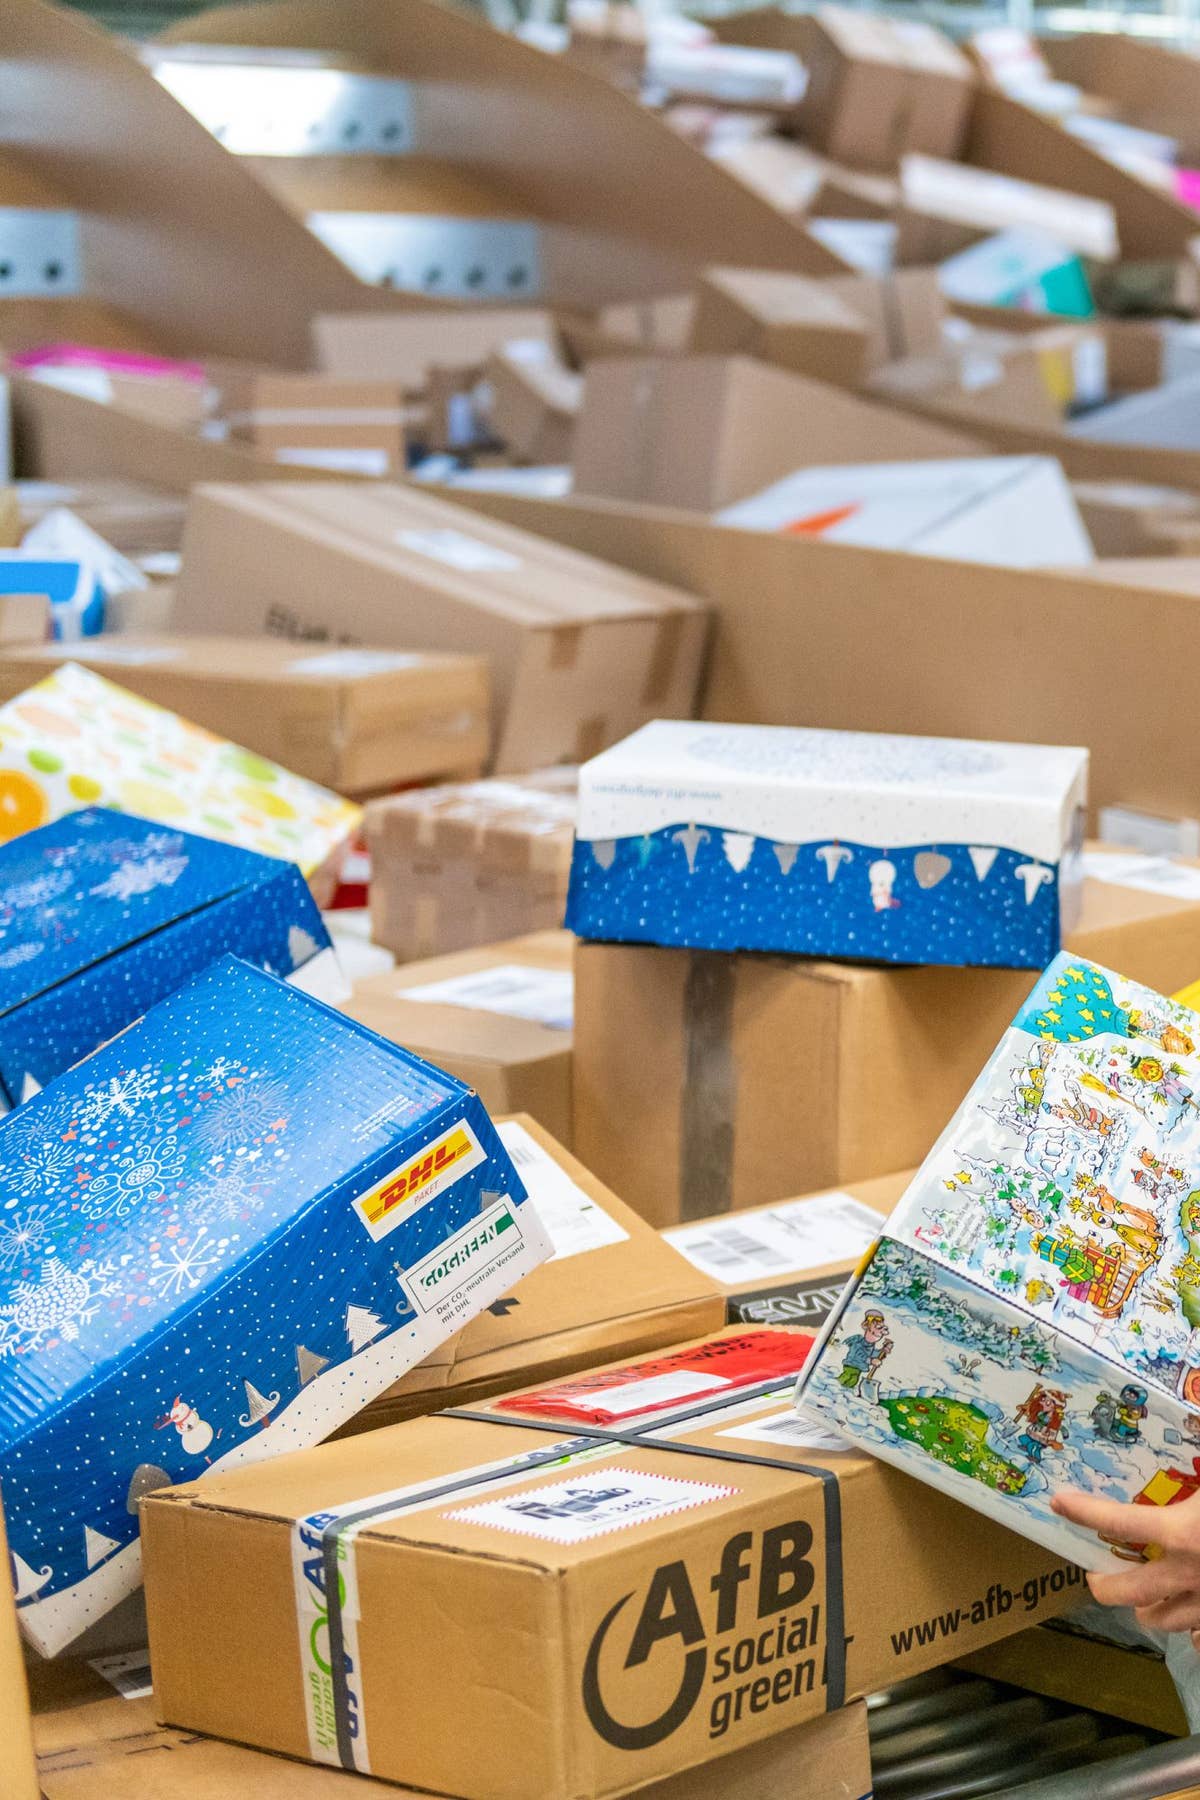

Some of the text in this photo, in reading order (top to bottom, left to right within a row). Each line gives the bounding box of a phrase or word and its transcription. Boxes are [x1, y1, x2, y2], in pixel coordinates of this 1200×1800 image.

[379, 1144, 457, 1212] DHL
[413, 1180, 440, 1205] PAKET
[435, 1301, 451, 1315] Der
[496, 1241, 526, 1268] Versand
[441, 1298, 471, 1324] mit DHL
[623, 1519, 816, 1671] AfB
[711, 1603, 821, 1684] social
[708, 1656, 817, 1740] green
